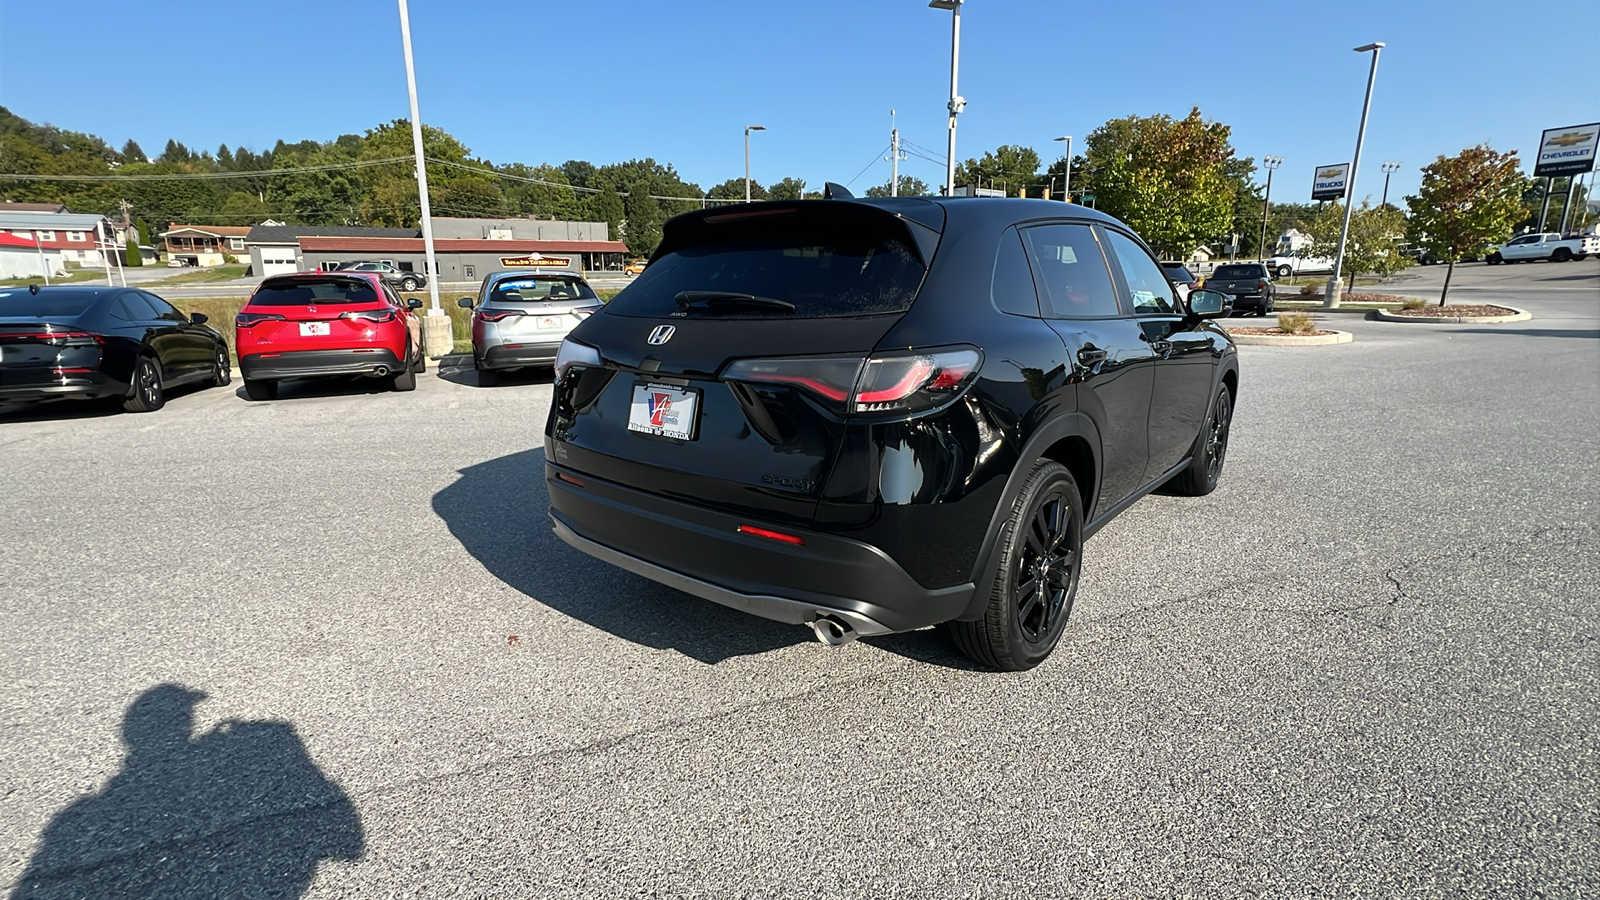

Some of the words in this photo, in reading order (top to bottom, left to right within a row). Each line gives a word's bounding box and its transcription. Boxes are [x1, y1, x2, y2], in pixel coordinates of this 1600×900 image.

[1541, 149, 1590, 160] CHEVROLET
[1316, 181, 1344, 189] TRUCKS
[663, 429, 690, 441] HONDA
